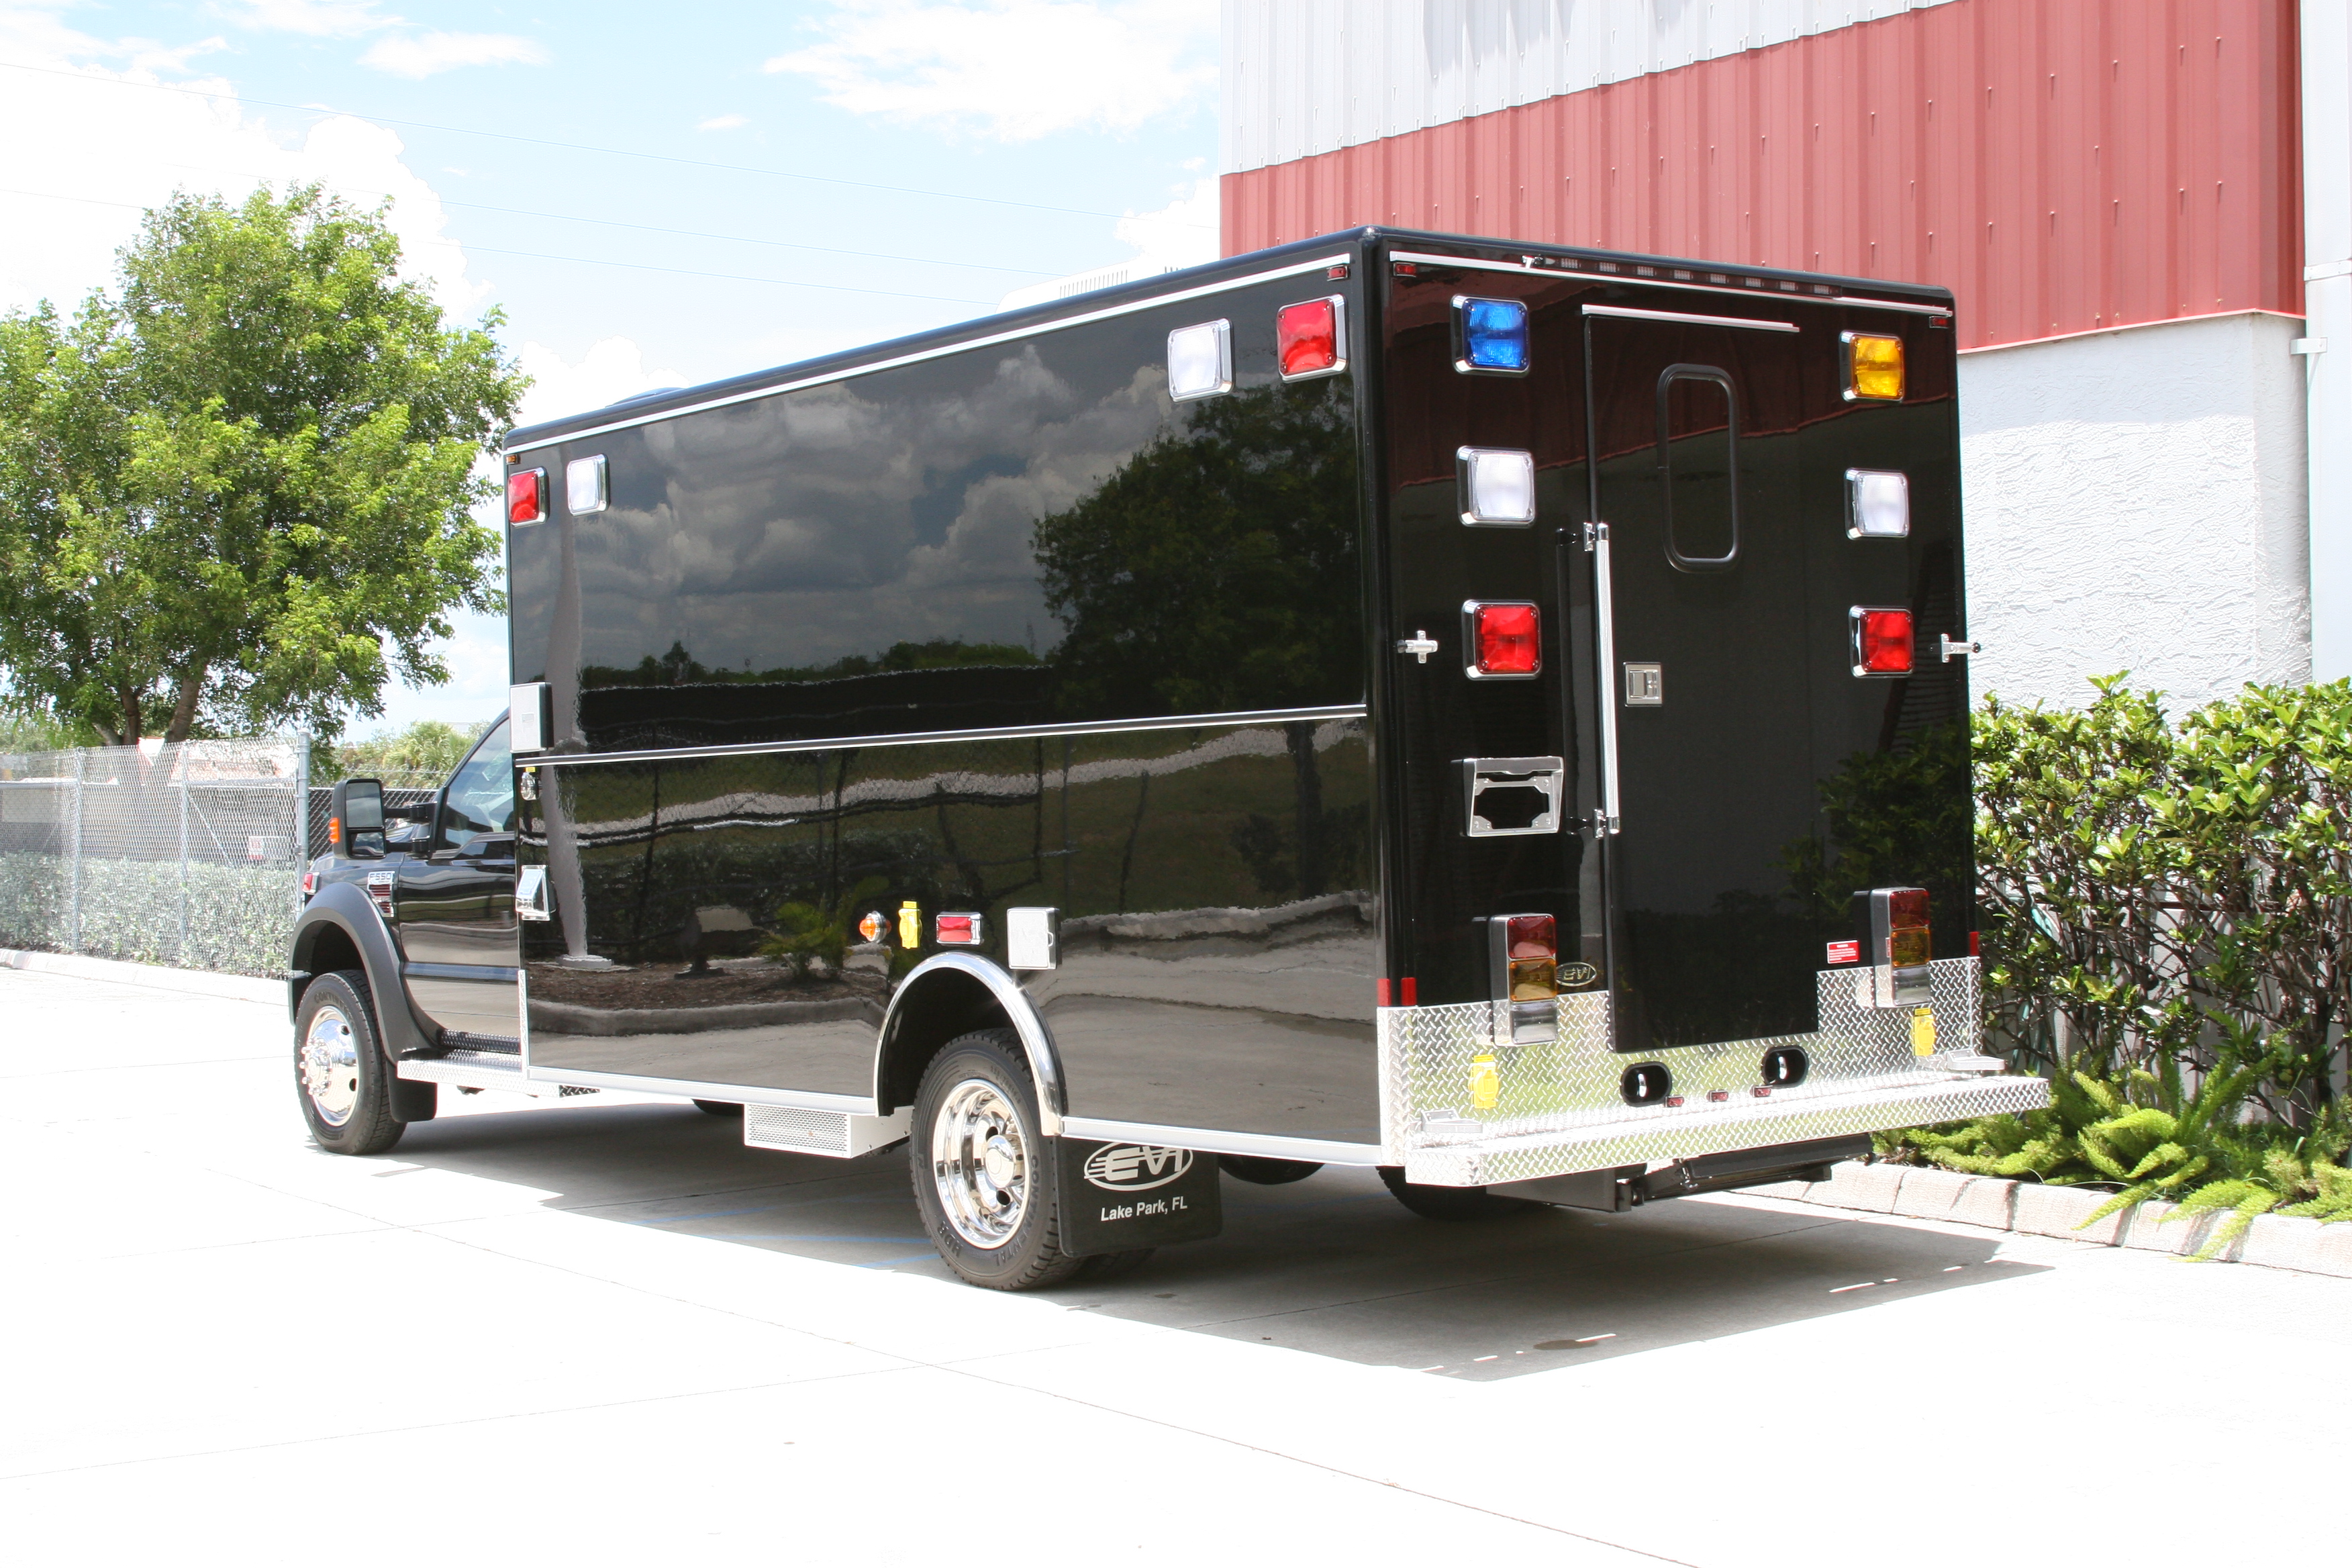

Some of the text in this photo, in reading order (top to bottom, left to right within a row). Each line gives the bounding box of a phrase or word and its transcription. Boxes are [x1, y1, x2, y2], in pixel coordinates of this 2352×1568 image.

[993, 1155, 1039, 1267] CONTINENTAL
[1101, 1195, 1187, 1221] Lake Park, FL
